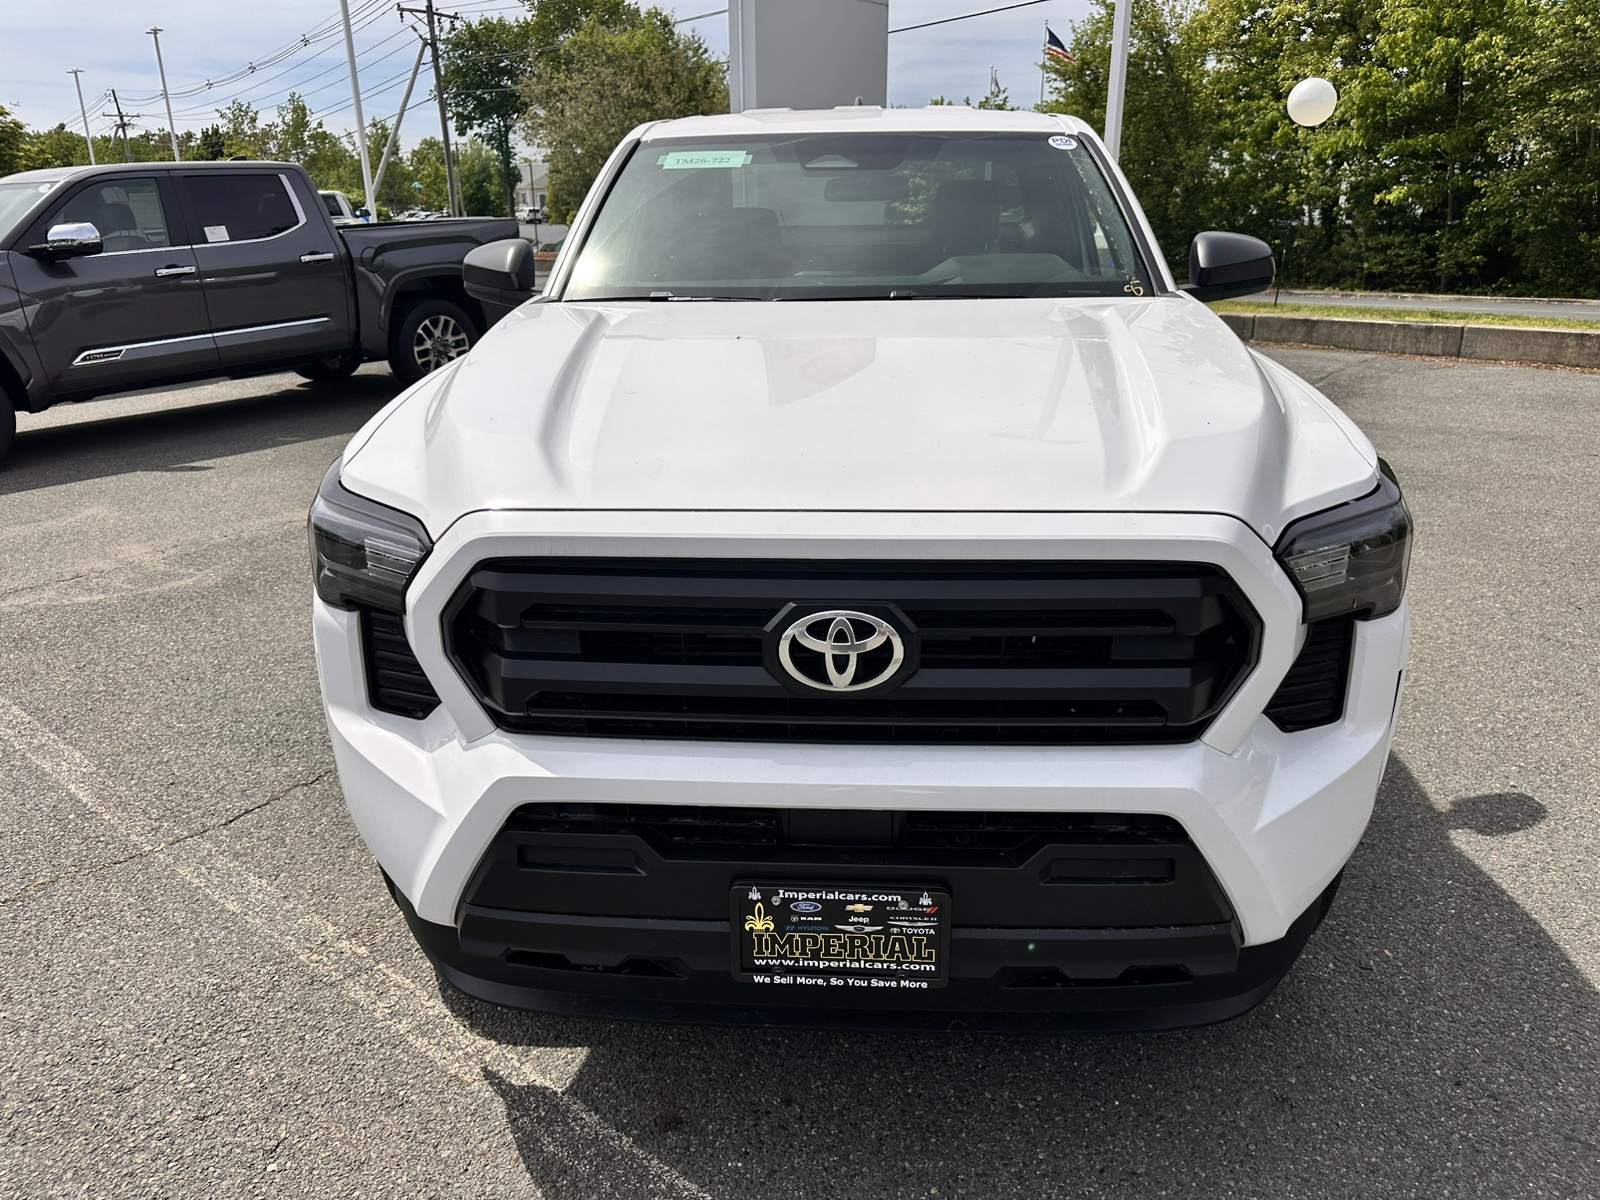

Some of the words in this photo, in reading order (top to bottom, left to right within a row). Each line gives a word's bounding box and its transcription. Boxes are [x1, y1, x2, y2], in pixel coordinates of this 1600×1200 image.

[675, 157, 731, 165] TM26-722
[778, 889, 902, 902] Imperialcars.com
[848, 915, 870, 924] Jeep
[901, 927, 936, 935] TOYOTA
[752, 932, 936, 963] IMPERIAL
[753, 958, 936, 972] www.imperialcars.com
[753, 975, 771, 984] We
[773, 975, 794, 985] Sell
[796, 976, 827, 987] More,
[829, 977, 844, 986] So
[846, 978, 868, 987] You
[870, 979, 898, 988] Save
[900, 980, 929, 989] More
